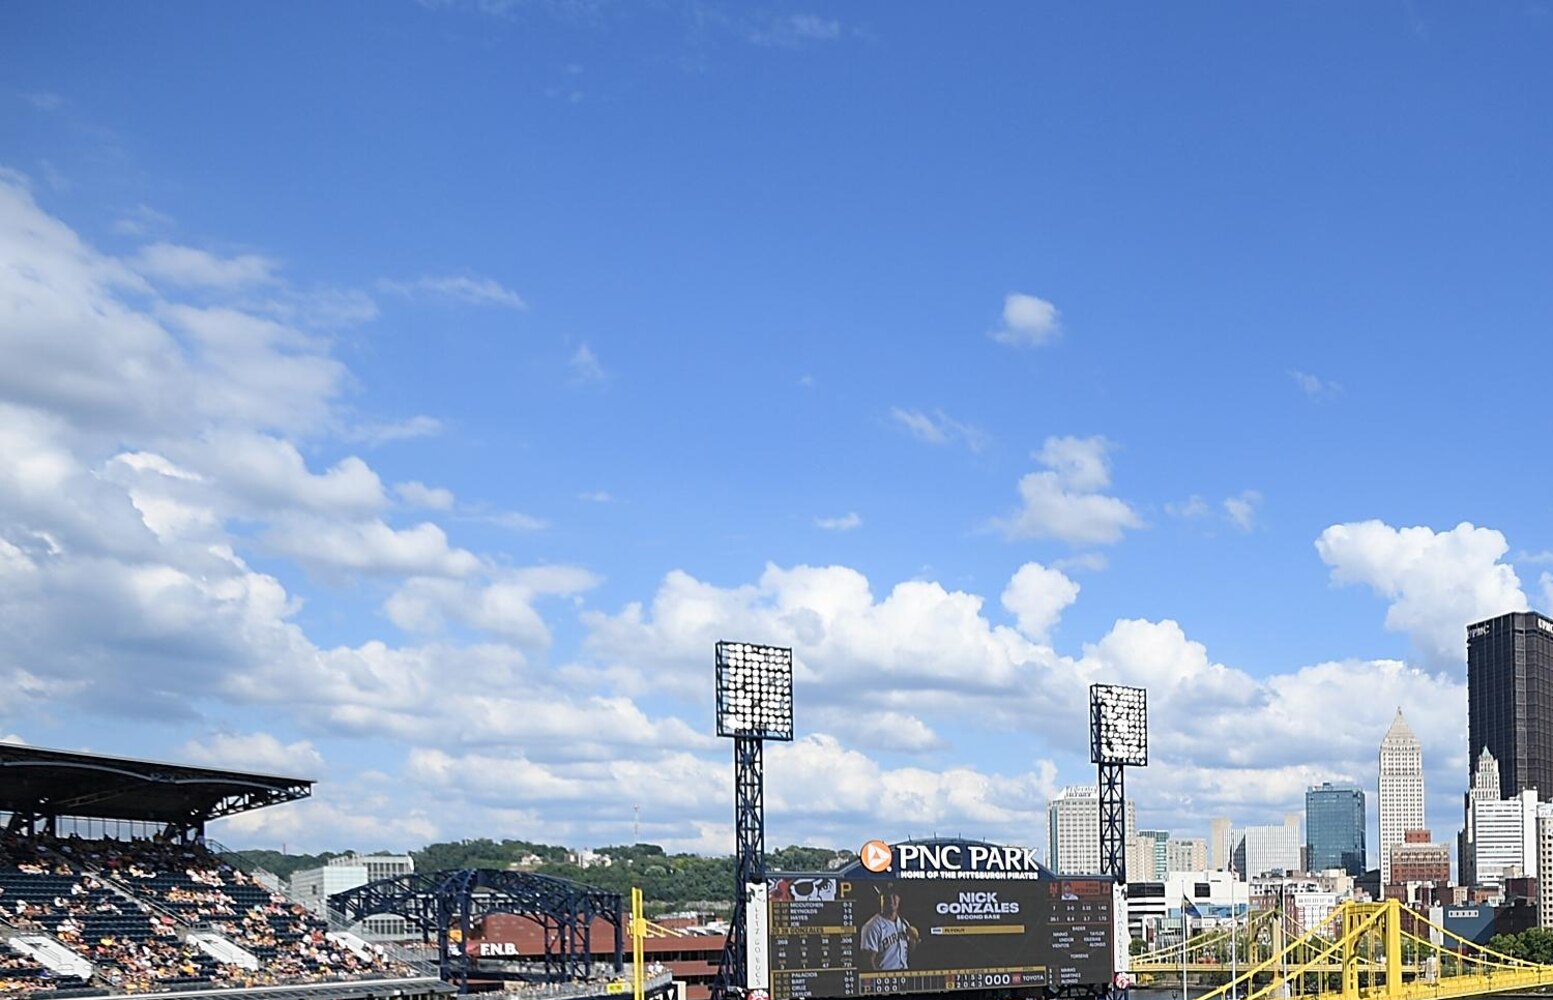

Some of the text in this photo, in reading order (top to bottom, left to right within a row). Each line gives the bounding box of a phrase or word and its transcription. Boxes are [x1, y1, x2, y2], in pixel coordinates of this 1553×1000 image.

[897, 845, 1039, 870] PNC PARK
[900, 871, 1039, 880] HOME OF THE PITTSBURGH PIRATES
[959, 892, 997, 903] NICK
[936, 903, 1019, 914] GONZALES
